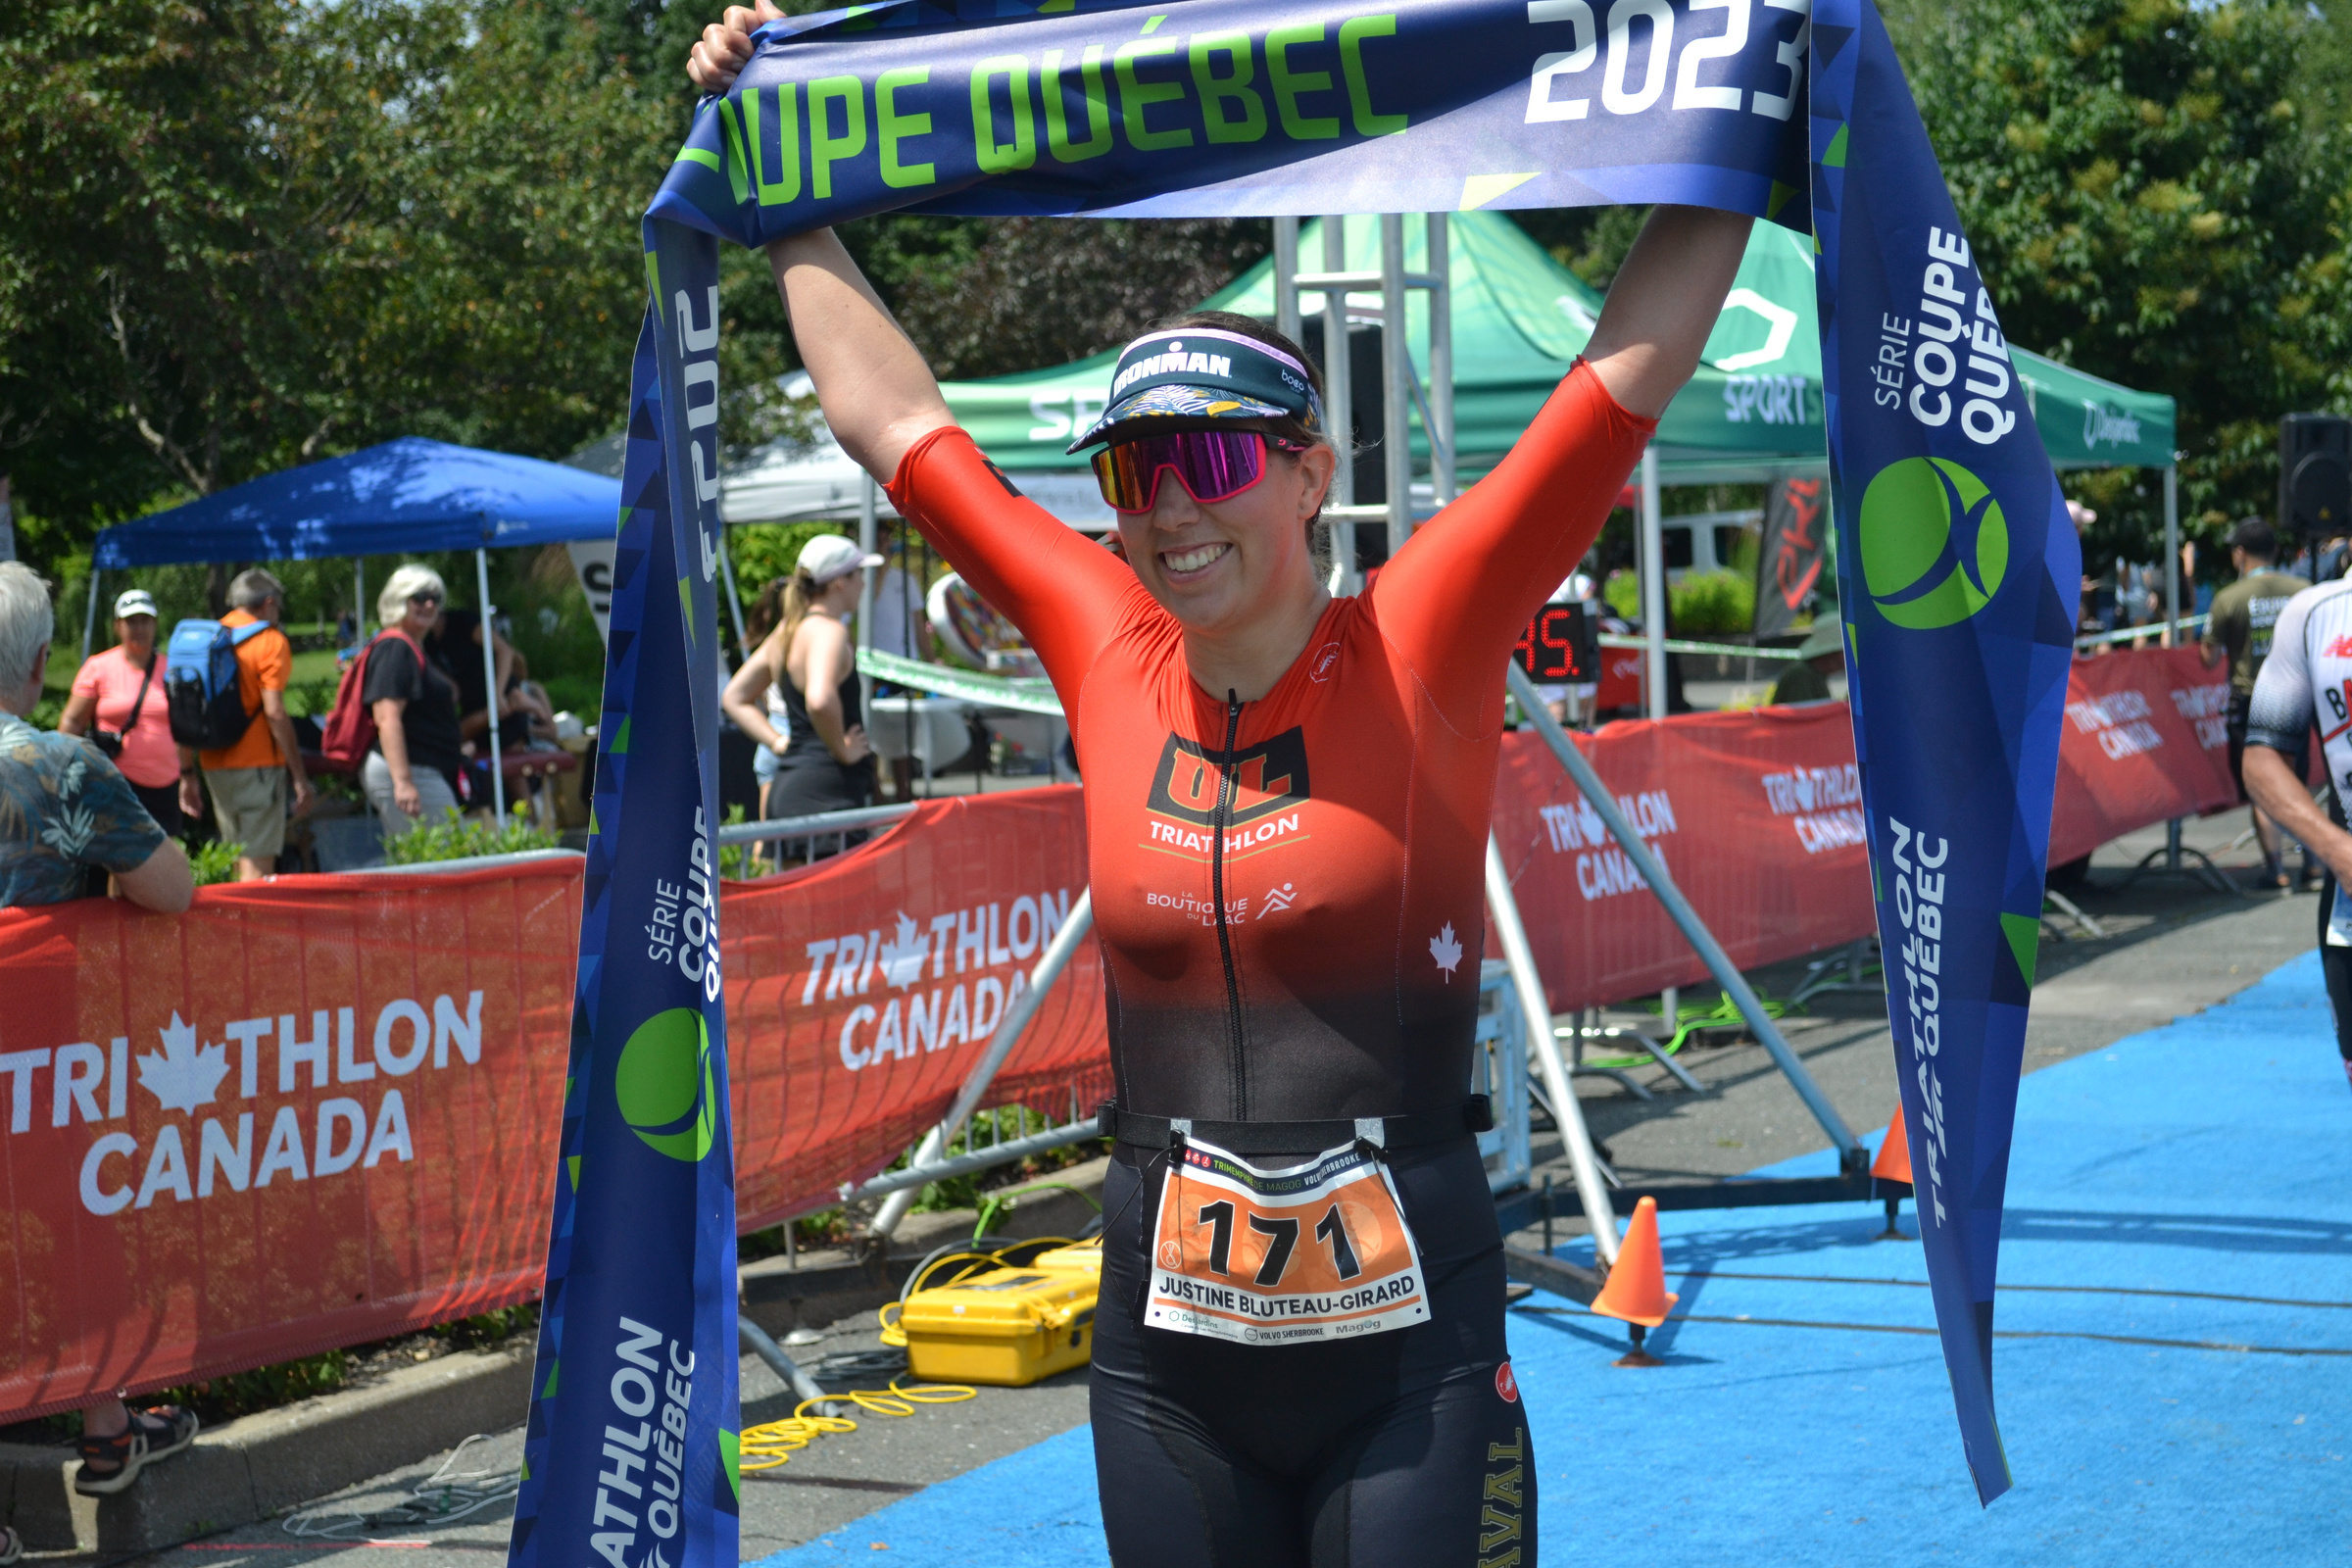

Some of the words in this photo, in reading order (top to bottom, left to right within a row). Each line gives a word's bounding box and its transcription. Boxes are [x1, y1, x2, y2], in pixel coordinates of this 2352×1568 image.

[674, 66, 936, 207] UPE
[970, 13, 1408, 175] QUÉBEC
[1524, 0, 1811, 124] 2023
[1870, 312, 1911, 411] SÉRIE
[1909, 226, 1970, 426] COUPE
[1150, 812, 1299, 854] TRIATHLON
[644, 878, 681, 965] SÉRIE
[1147, 892, 1249, 915] BOUTIQUE
[1181, 890, 1194, 899] LA
[1915, 831, 1949, 1057] QUÉBEC
[1889, 815, 1946, 1229] TRIATHLON
[79, 1088, 415, 1217] CANADA
[1266, 1178, 1302, 1192] MAGOG
[1198, 1199, 1362, 1288] 171
[1159, 1276, 1235, 1310] JUSTINE
[1239, 1275, 1415, 1318] BLUTEAU-GIRARD
[1259, 1331, 1281, 1341] VOLVO
[1282, 1327, 1324, 1339] SHERBROOKE
[1335, 1319, 1382, 1335] Magog
[647, 1339, 696, 1540] QUÉBEC
